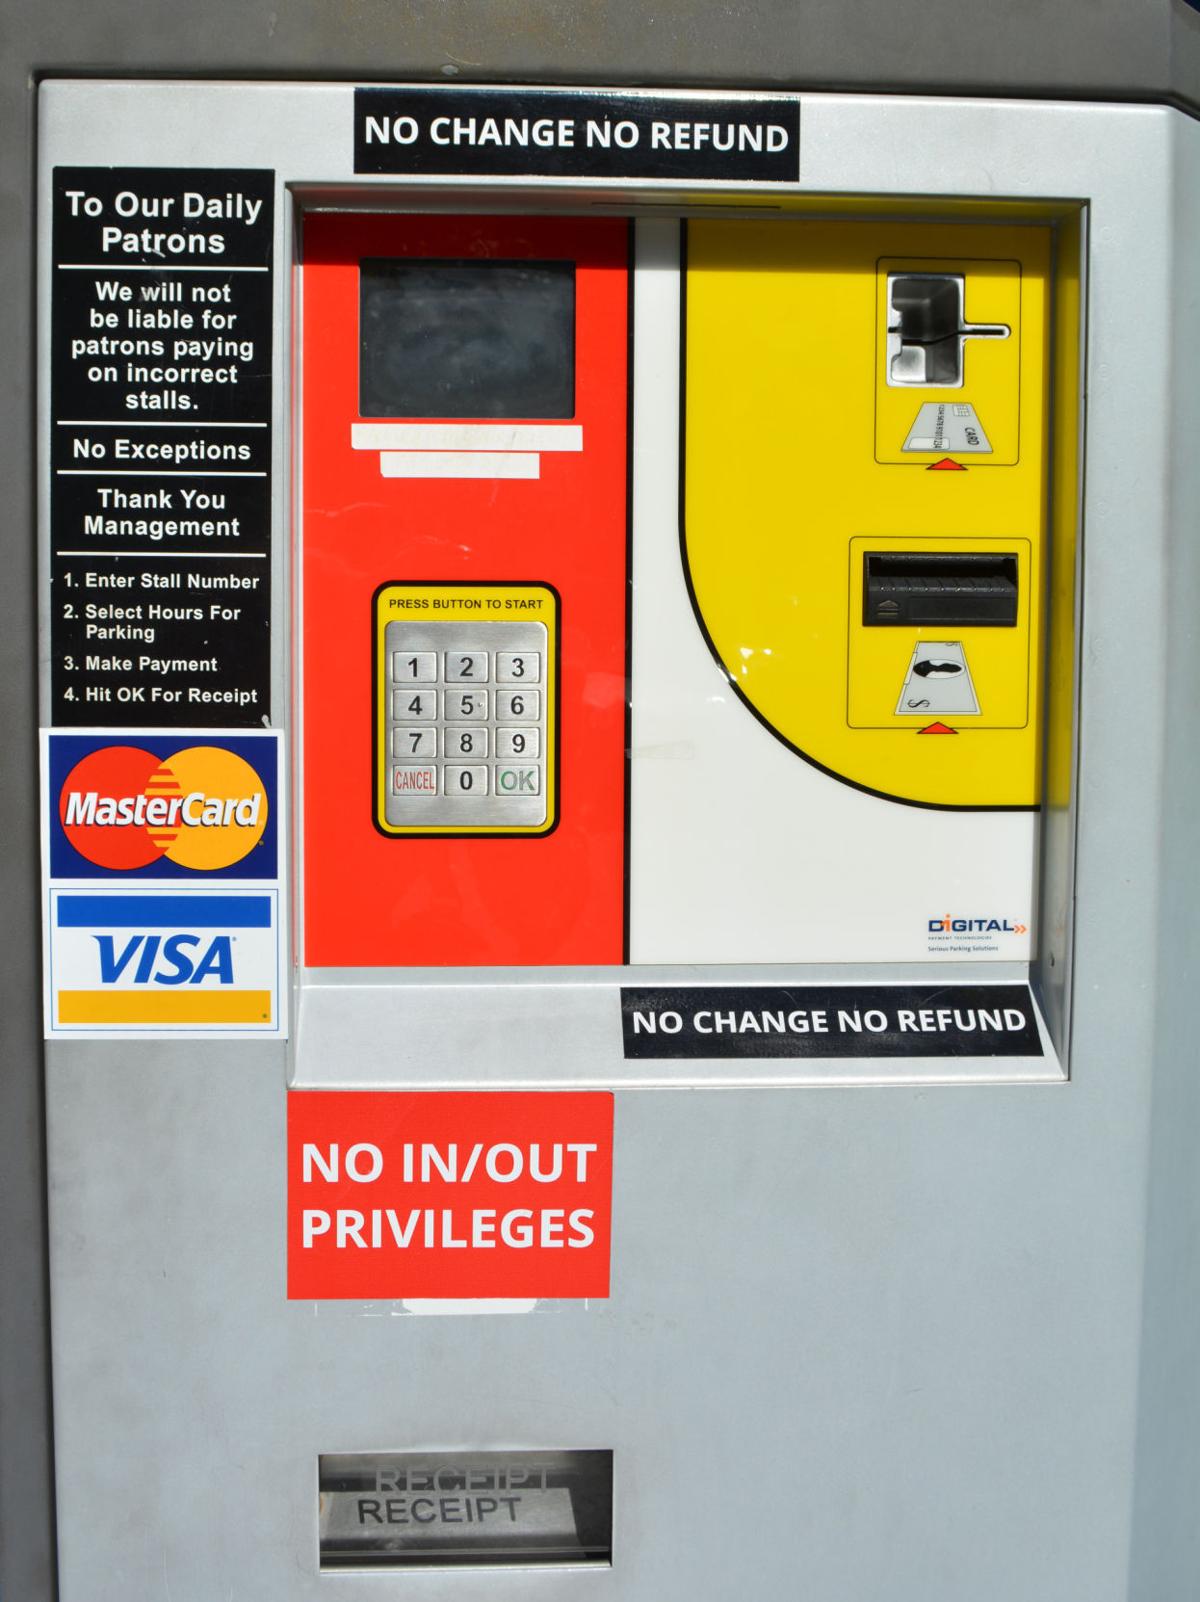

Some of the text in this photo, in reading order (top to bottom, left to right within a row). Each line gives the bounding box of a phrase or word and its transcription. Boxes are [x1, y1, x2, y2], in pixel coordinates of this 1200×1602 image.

[364, 116, 789, 152] NO CHANGE NO REFUND
[65, 191, 262, 225] To Our Daily
[102, 227, 225, 254] Patrons
[95, 281, 231, 302] We will not
[90, 309, 237, 329] be liable for
[72, 337, 254, 361] patrons paying
[88, 364, 238, 383] on incorrect
[126, 391, 198, 410] stalls.
[964, 427, 980, 446] CARD
[73, 439, 251, 464] No Exceptions
[98, 489, 225, 509] Thank You
[84, 516, 240, 540] Management
[63, 573, 260, 589] 1. Enter Stall Number
[63, 605, 241, 620] 2. Select Hours For
[389, 599, 543, 609] PRESS BUTTON TO START
[86, 625, 155, 643] Parking
[64, 656, 218, 674] 3. Make Payment
[408, 657, 524, 677] 1 2 3
[64, 687, 258, 706] 4. Hit OK For Receipt
[408, 696, 524, 715] 4 5 6
[409, 733, 525, 753] 7 8 9
[396, 771, 535, 791] CANCEL 0 OK
[65, 792, 262, 827] MasterCard
[91, 934, 234, 985] VISA
[633, 1008, 1026, 1034] NO CHANGE NO REFUND
[303, 1143, 597, 1183] NO IN/OUT
[303, 1209, 595, 1248] PRIVILEGES
[376, 1464, 555, 1493] RECEIPT
[358, 1497, 522, 1524] RECEIPT
